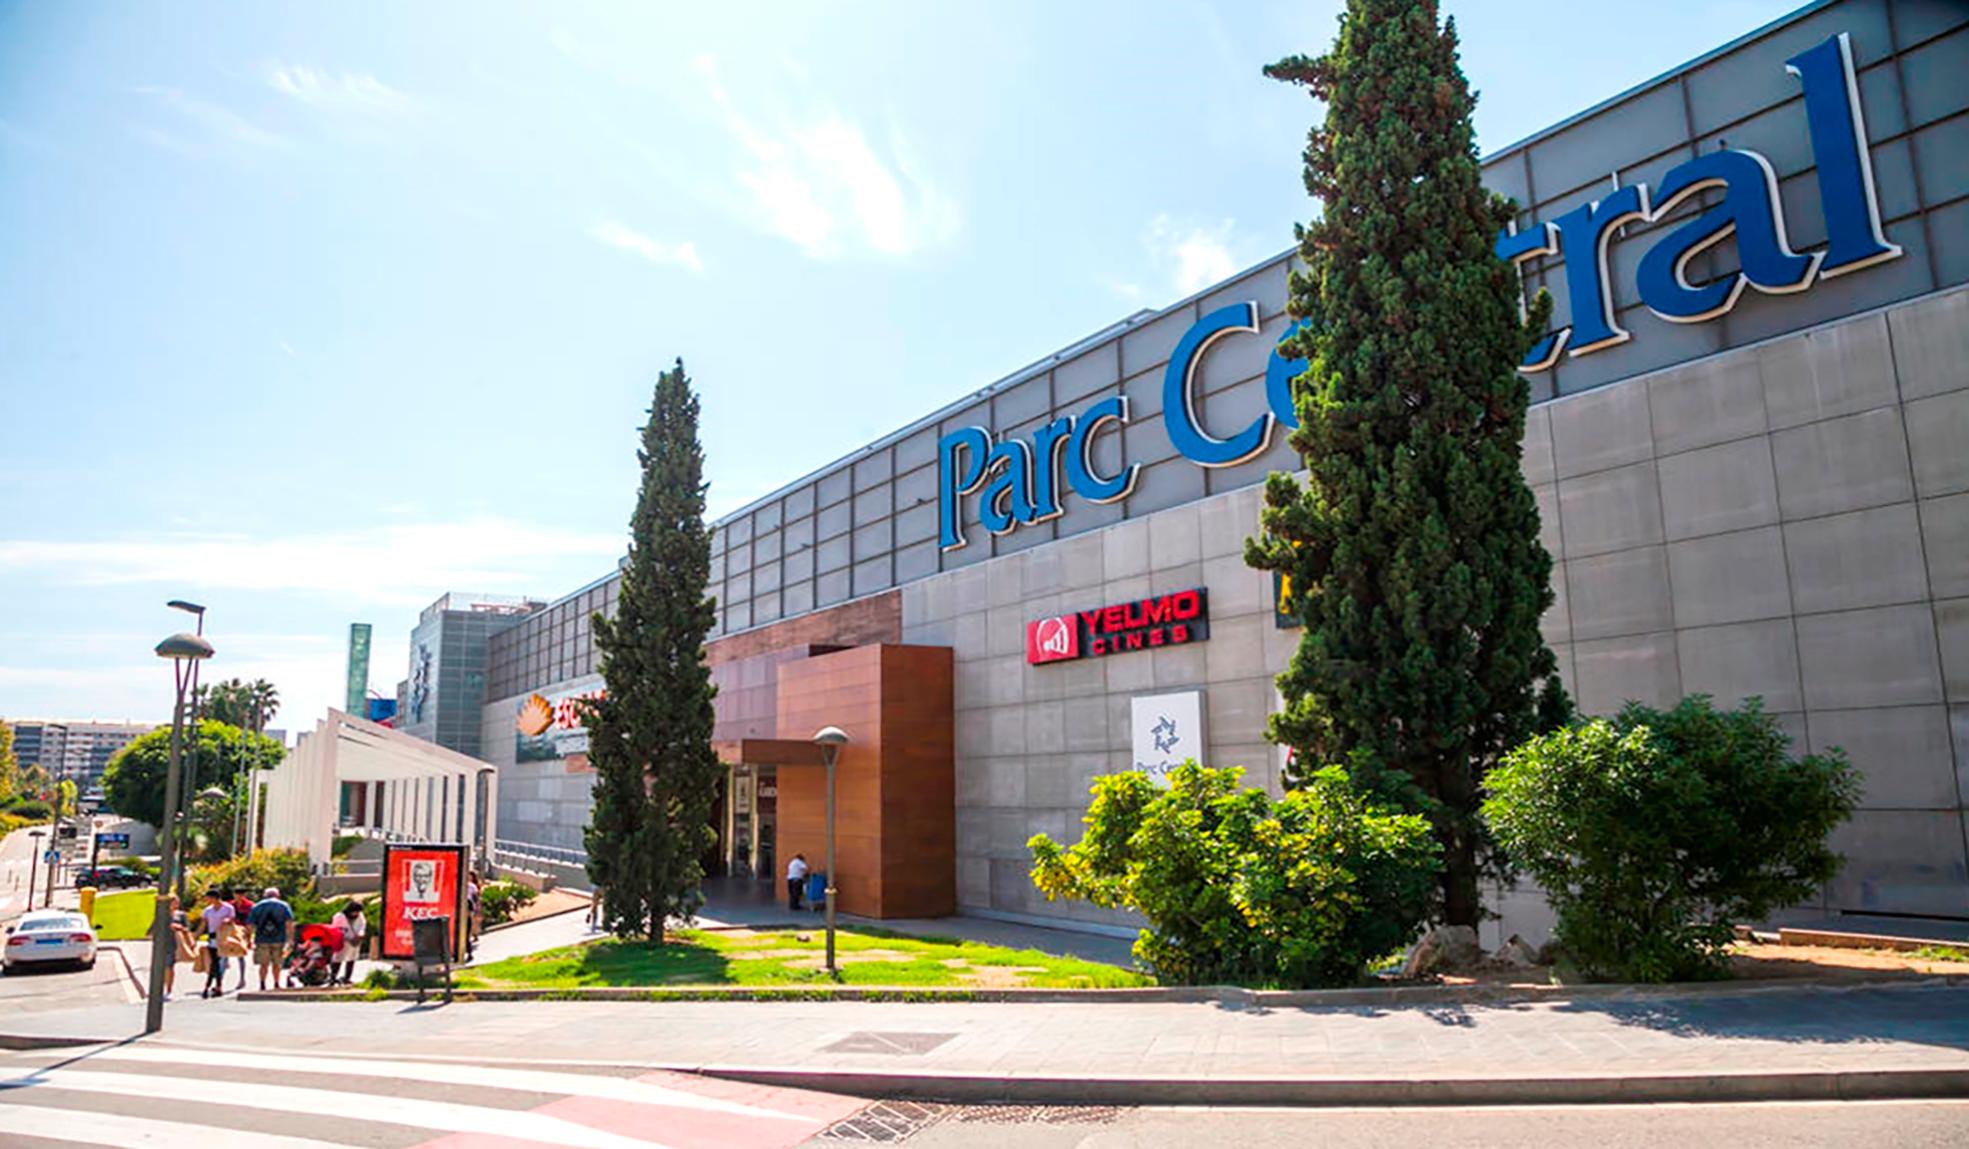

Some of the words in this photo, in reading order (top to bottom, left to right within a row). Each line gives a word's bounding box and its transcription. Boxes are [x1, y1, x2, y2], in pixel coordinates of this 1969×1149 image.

[938, 396, 1141, 553] Parc
[1083, 591, 1199, 634] YELMO
[1093, 625, 1187, 655] CINES
